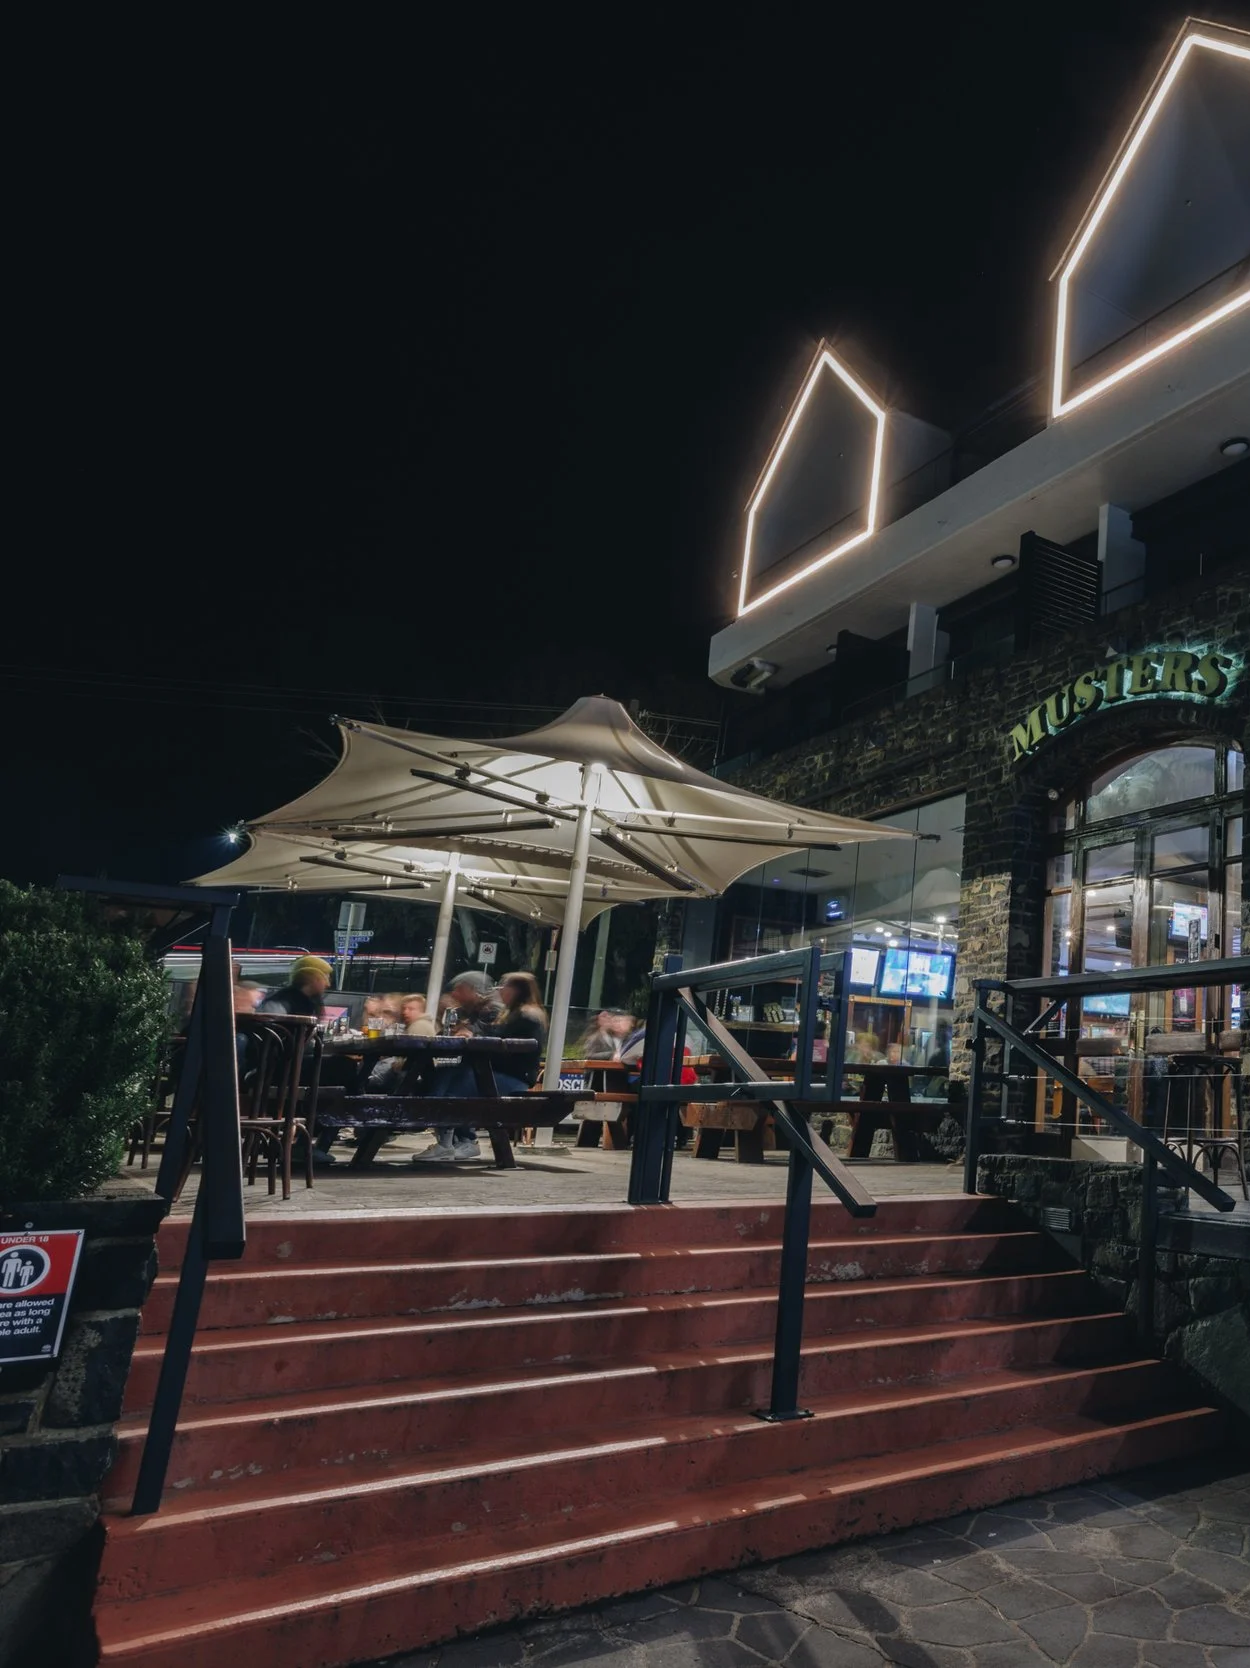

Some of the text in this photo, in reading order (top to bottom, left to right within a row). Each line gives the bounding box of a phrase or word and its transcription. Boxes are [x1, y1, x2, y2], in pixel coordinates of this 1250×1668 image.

[1010, 650, 1233, 762] MUSTERS
[1, 1235, 49, 1244] UNDER 18
[15, 1298, 55, 1309] allowed
[0, 1308, 51, 1318] ea as long
[12, 1317, 34, 1327] with
[13, 1325, 41, 1335] adult.
